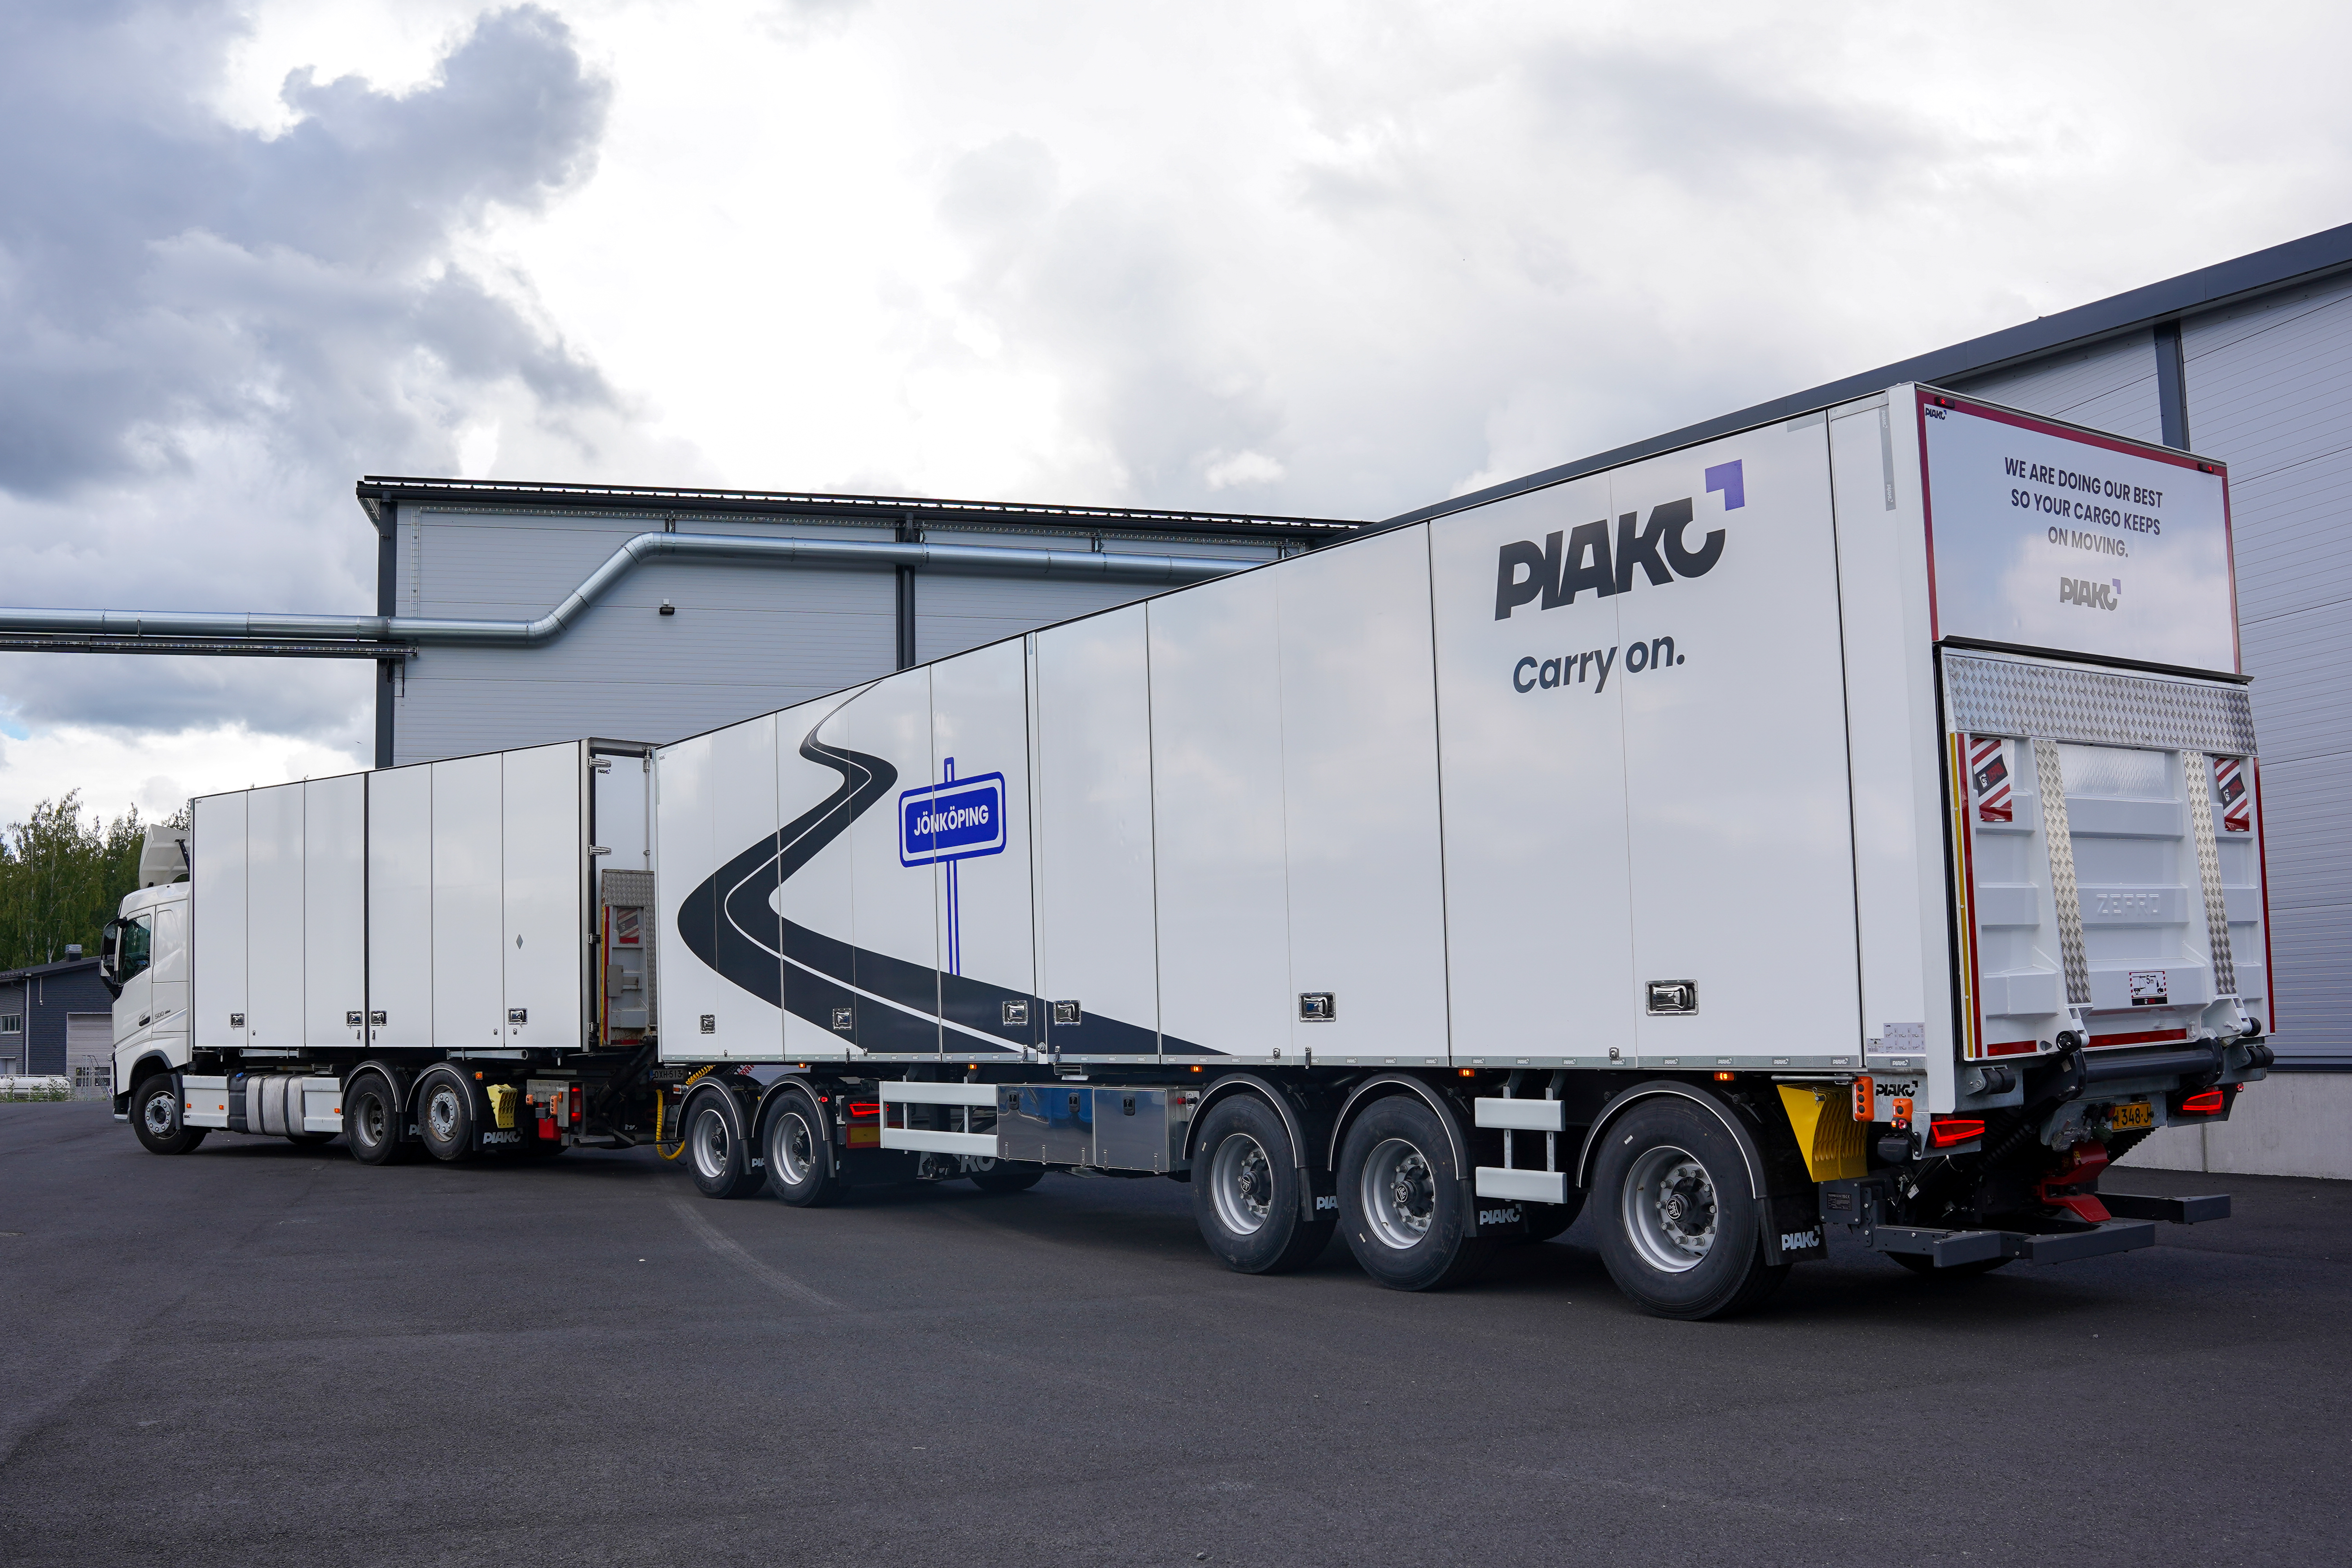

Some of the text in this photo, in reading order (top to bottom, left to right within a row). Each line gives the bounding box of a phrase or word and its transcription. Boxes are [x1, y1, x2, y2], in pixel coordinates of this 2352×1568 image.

[2005, 457, 2163, 508] WE ARE DOING OUR BEST
[2011, 489, 2160, 535] SO YOUR CARGO KEEPS
[2048, 526, 2128, 557] ON MOVING.
[1513, 636, 1685, 694] Carry on.
[914, 805, 989, 836] JÖNKÖPING
[1317, 1196, 1338, 1210] PIA
